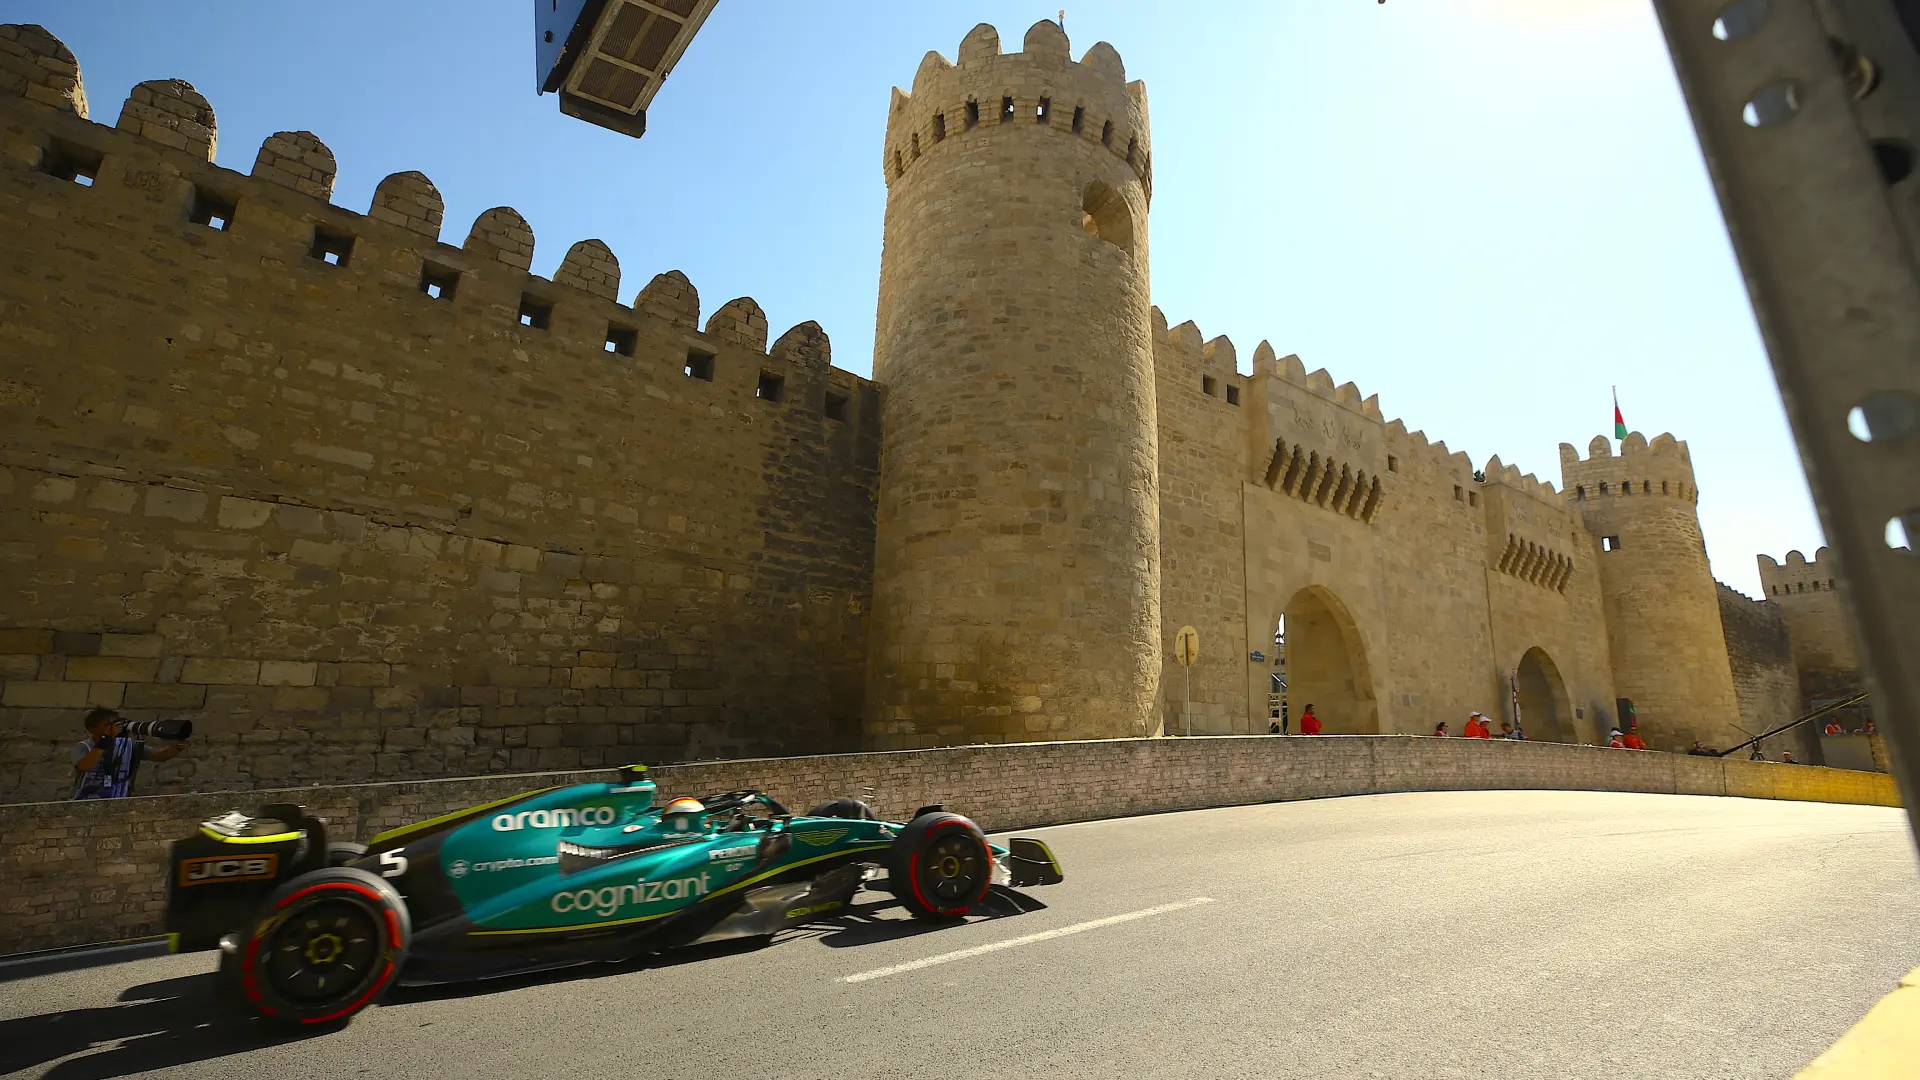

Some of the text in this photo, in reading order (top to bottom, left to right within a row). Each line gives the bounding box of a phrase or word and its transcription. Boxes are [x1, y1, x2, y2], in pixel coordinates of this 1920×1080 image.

[492, 806, 616, 832] aramco
[188, 859, 269, 880] JCB
[380, 847, 408, 878] 5
[472, 856, 560, 872] crypto.com
[551, 871, 711, 917] cognizant
